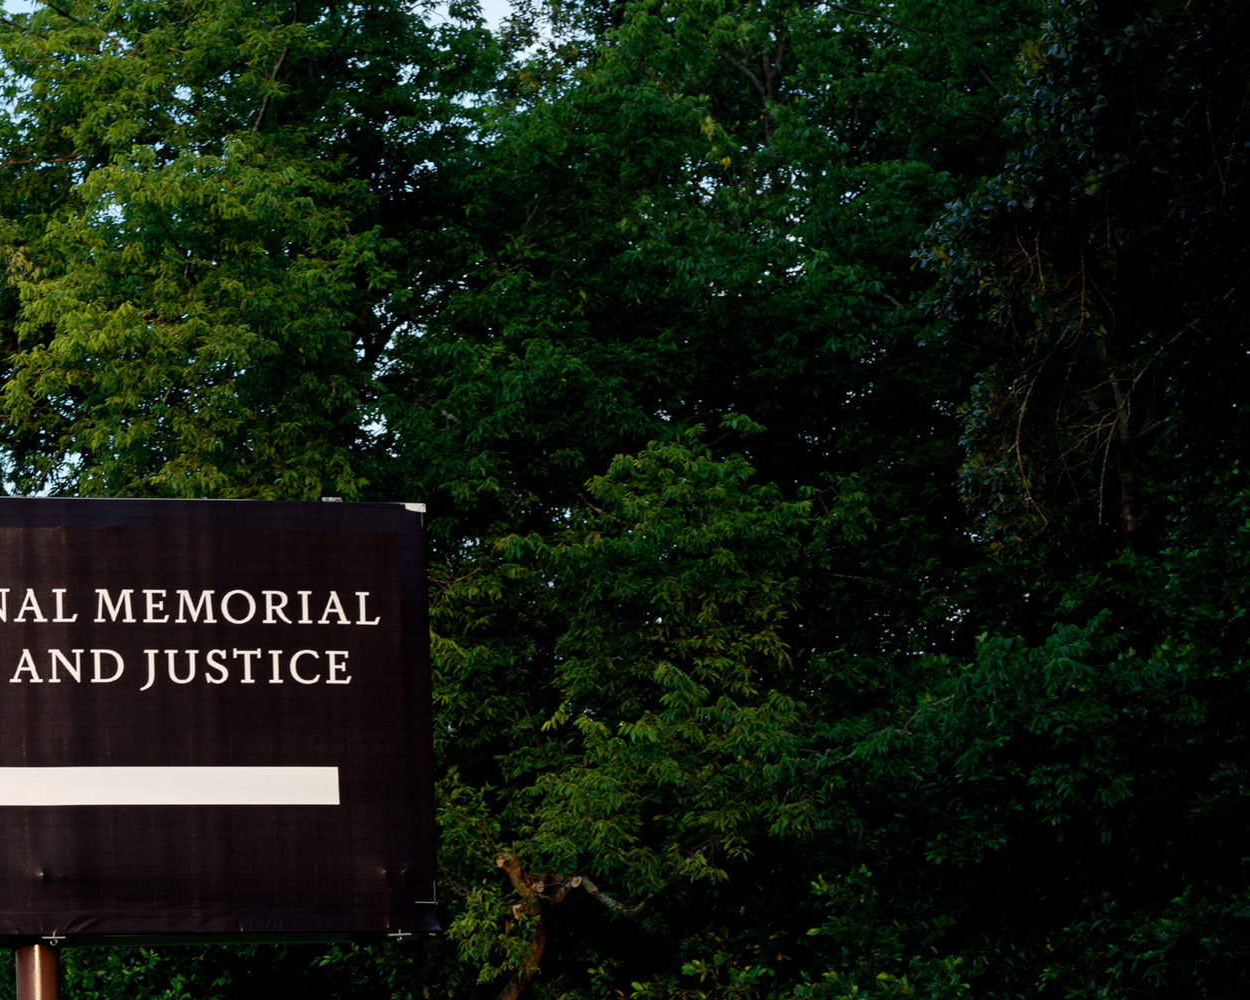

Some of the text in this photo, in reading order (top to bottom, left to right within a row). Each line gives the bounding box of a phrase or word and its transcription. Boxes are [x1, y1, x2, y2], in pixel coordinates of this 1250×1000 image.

[93, 587, 381, 626] MEMORIAL
[9, 647, 125, 684] AND
[139, 647, 352, 692] JUSTICE
